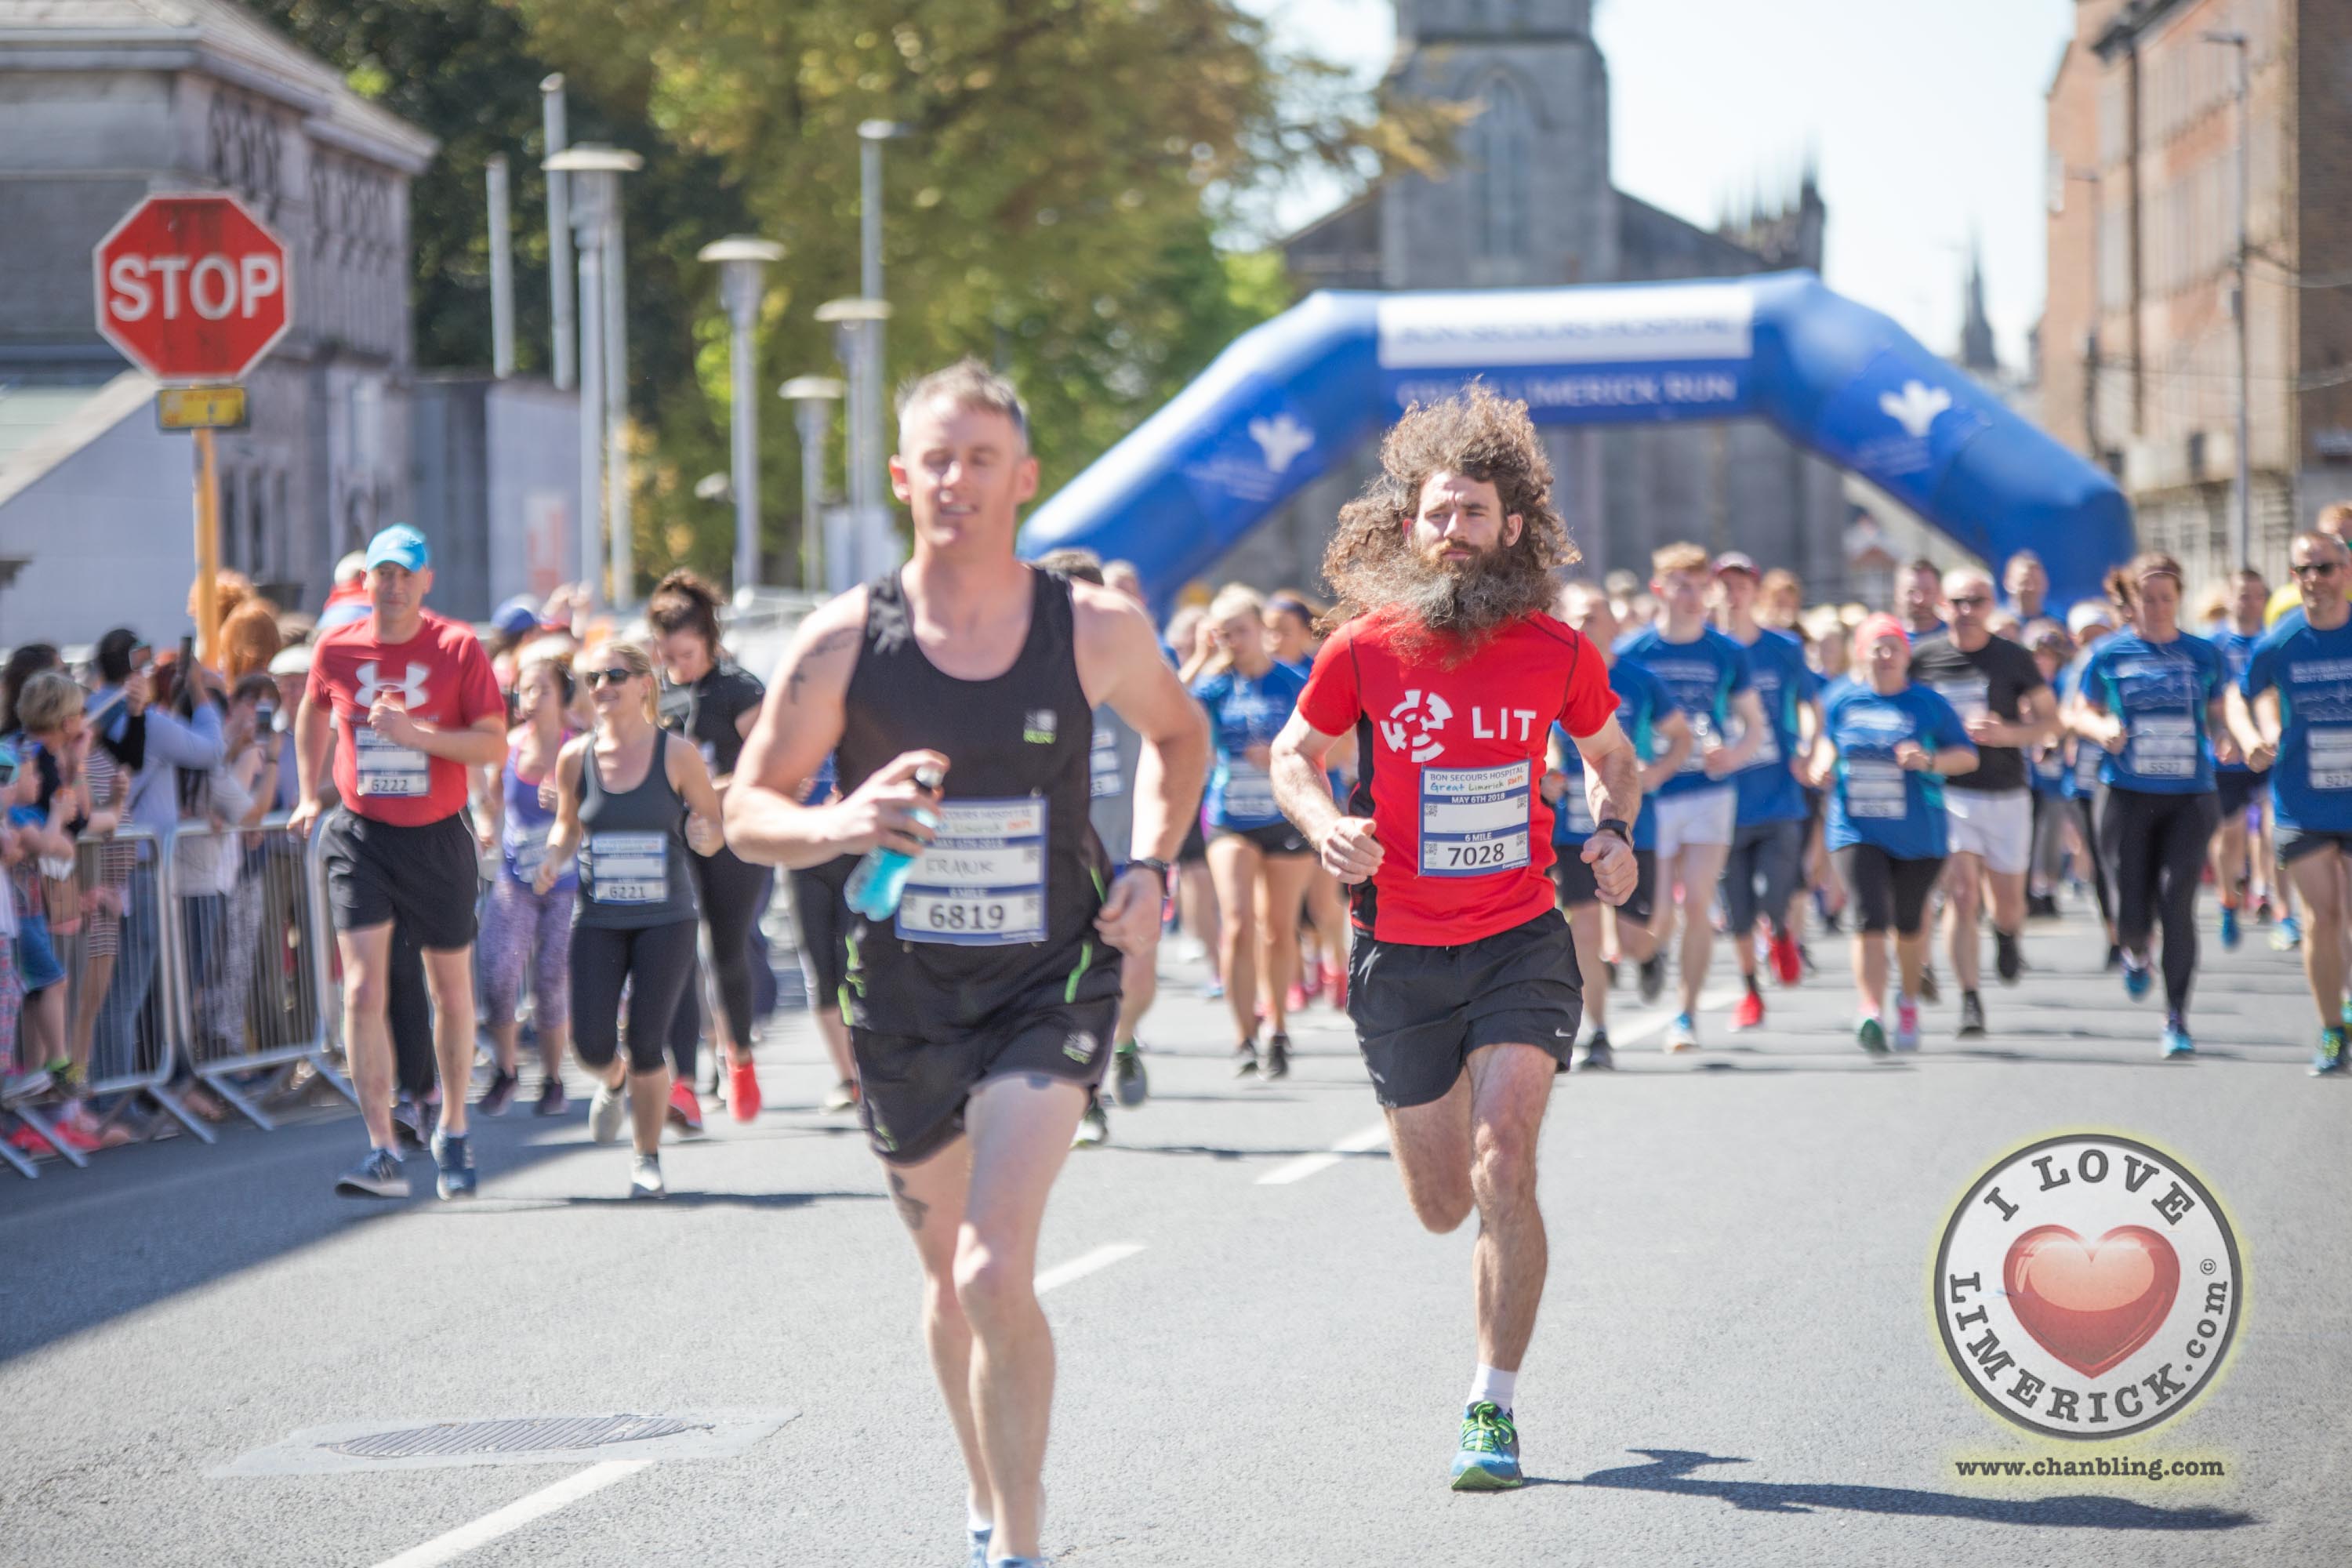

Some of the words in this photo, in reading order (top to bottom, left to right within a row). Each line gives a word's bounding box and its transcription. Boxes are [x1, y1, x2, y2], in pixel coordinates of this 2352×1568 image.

[110, 254, 279, 321] STOP
[1662, 371, 1738, 403] RUN
[1472, 706, 1537, 741] LIT
[1450, 773, 1488, 782] SECOURS
[1490, 767, 1524, 780] HOSPITAL
[372, 779, 408, 792] 6222
[1430, 782, 1465, 793] Great
[1468, 781, 1504, 792] Limerick
[1471, 794, 1486, 804] 6TH
[1487, 792, 1505, 802] 2018
[1472, 832, 1492, 842] MILE
[1447, 843, 1504, 866] 7028
[609, 886, 646, 898] 6221
[929, 904, 1005, 930] 6819
